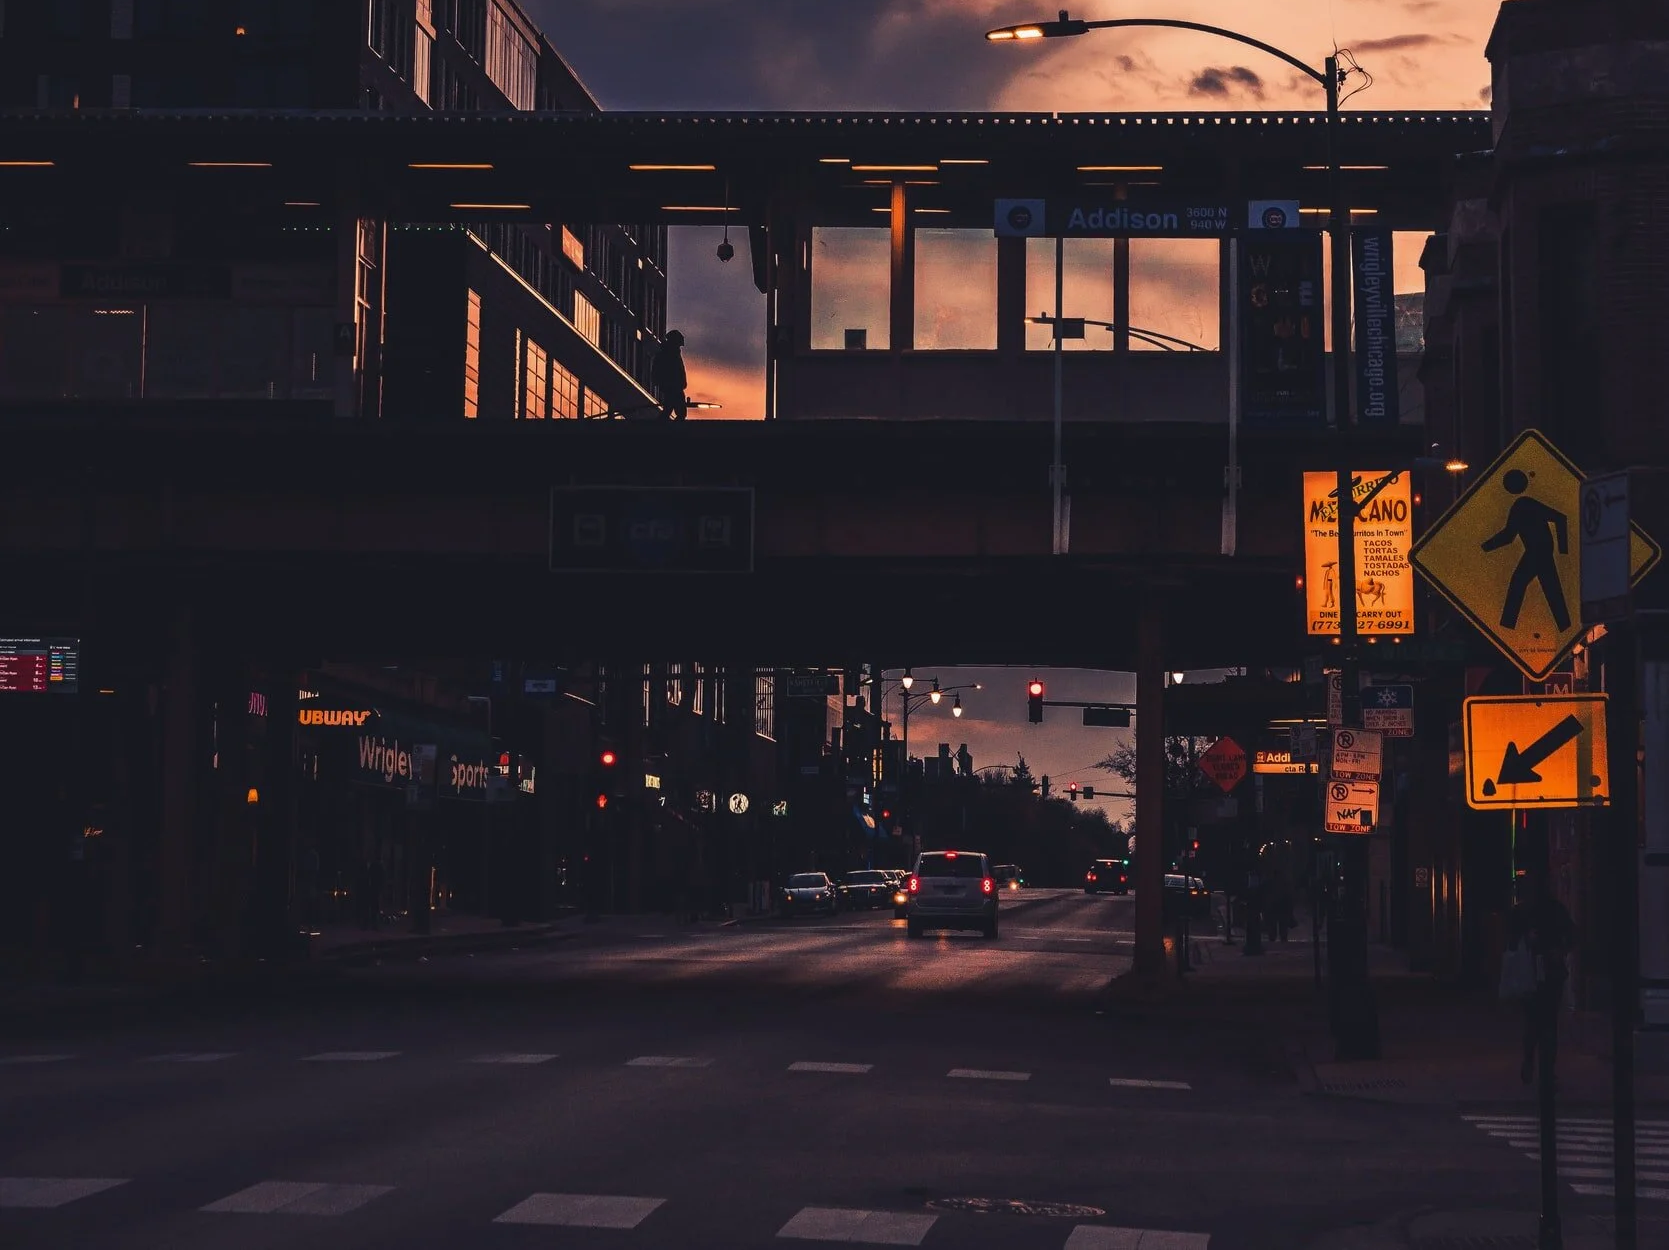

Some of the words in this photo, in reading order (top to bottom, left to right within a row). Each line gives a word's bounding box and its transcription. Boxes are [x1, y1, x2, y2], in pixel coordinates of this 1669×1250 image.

[1066, 207, 1178, 230] Addison
[1186, 207, 1214, 218] 3600
[1217, 207, 1228, 217] N
[1190, 219, 1212, 230] 940
[1214, 219, 1227, 229] W
[1359, 236, 1387, 417] wrigleyvillechicago.org
[1310, 499, 1407, 523] MECANO
[1353, 530, 1375, 538] urritos
[1364, 554, 1404, 562] TAMALES
[1364, 562, 1410, 570] TOSTADAS
[1319, 611, 1338, 619] DINE
[1312, 621, 1341, 630] (773
[1357, 620, 1410, 630] 27-6991
[299, 709, 372, 726] UBWAY
[1266, 753, 1291, 763] Addi
[1336, 771, 1352, 779] TOW
[1356, 773, 1376, 781] ZONE
[1350, 824, 1371, 833] ZONE
